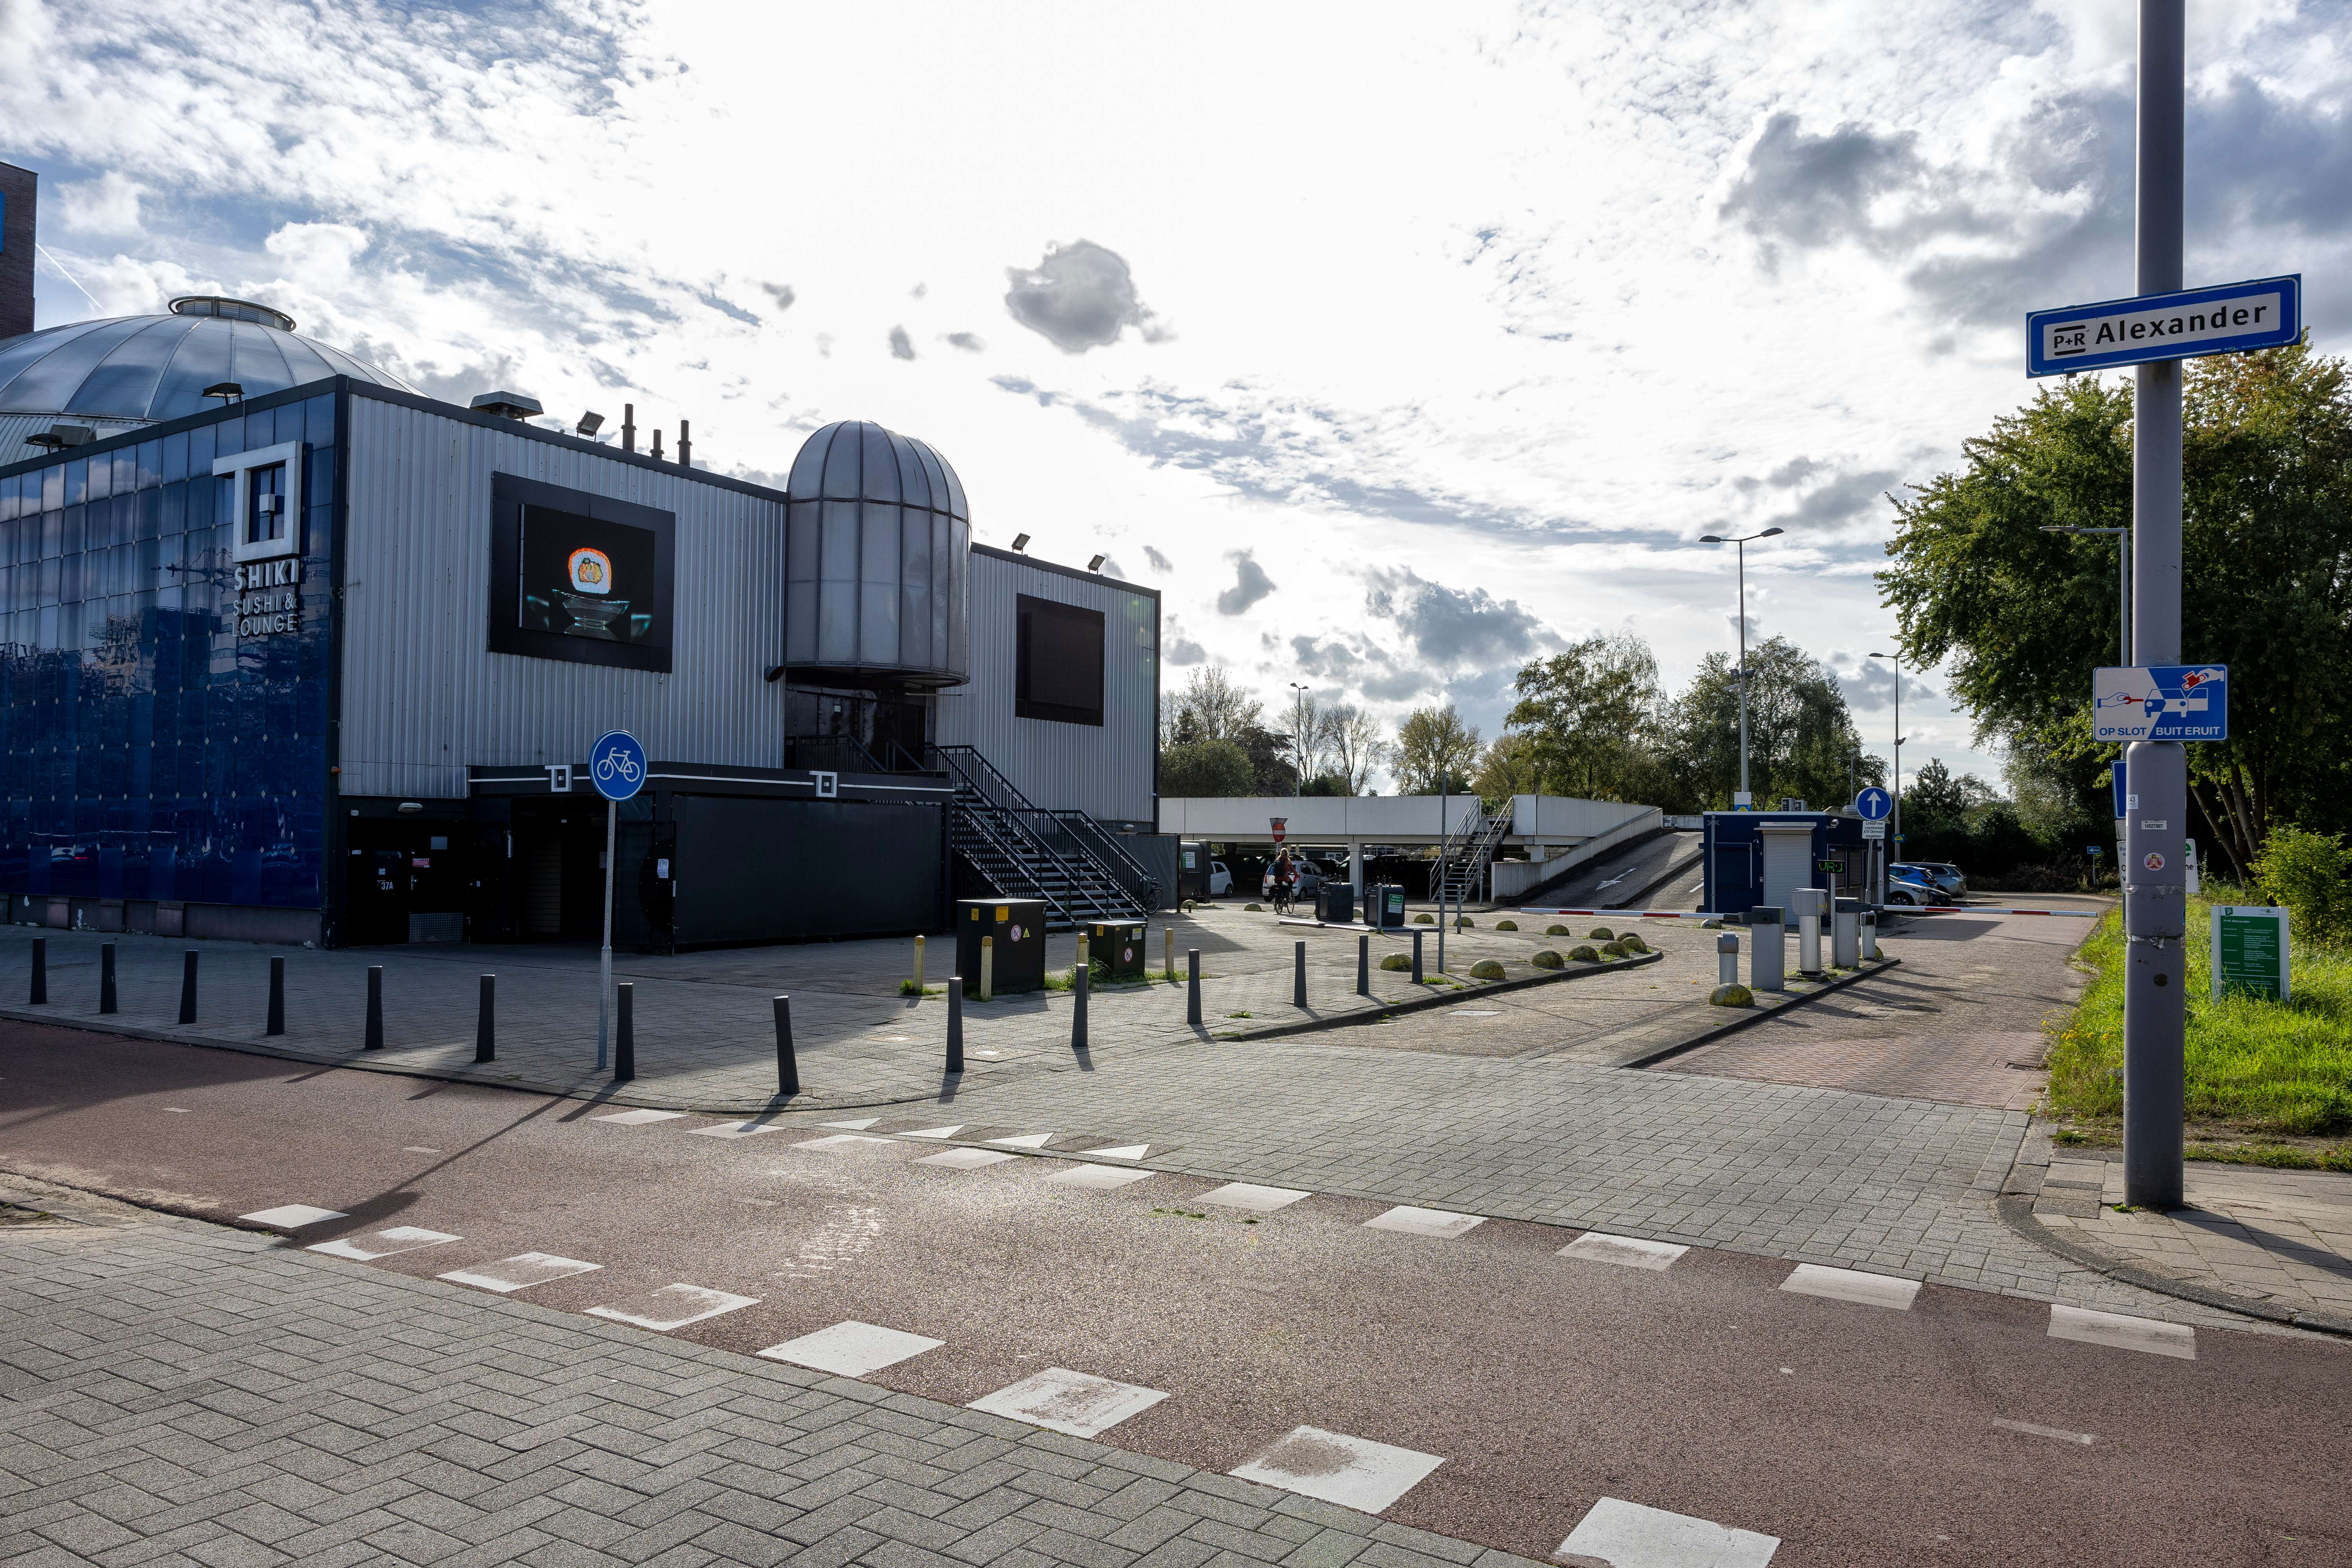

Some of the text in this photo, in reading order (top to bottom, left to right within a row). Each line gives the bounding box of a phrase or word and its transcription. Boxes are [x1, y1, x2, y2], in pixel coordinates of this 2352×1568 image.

[2054, 305, 2267, 349] P+R Alexander
[234, 558, 299, 591] SHIKI
[233, 592, 295, 616] SUSHI &
[232, 613, 295, 637] LOUNGE
[2099, 726, 2221, 735] OP SLOT BUIT ERUIT
[381, 882, 393, 890] 37A
